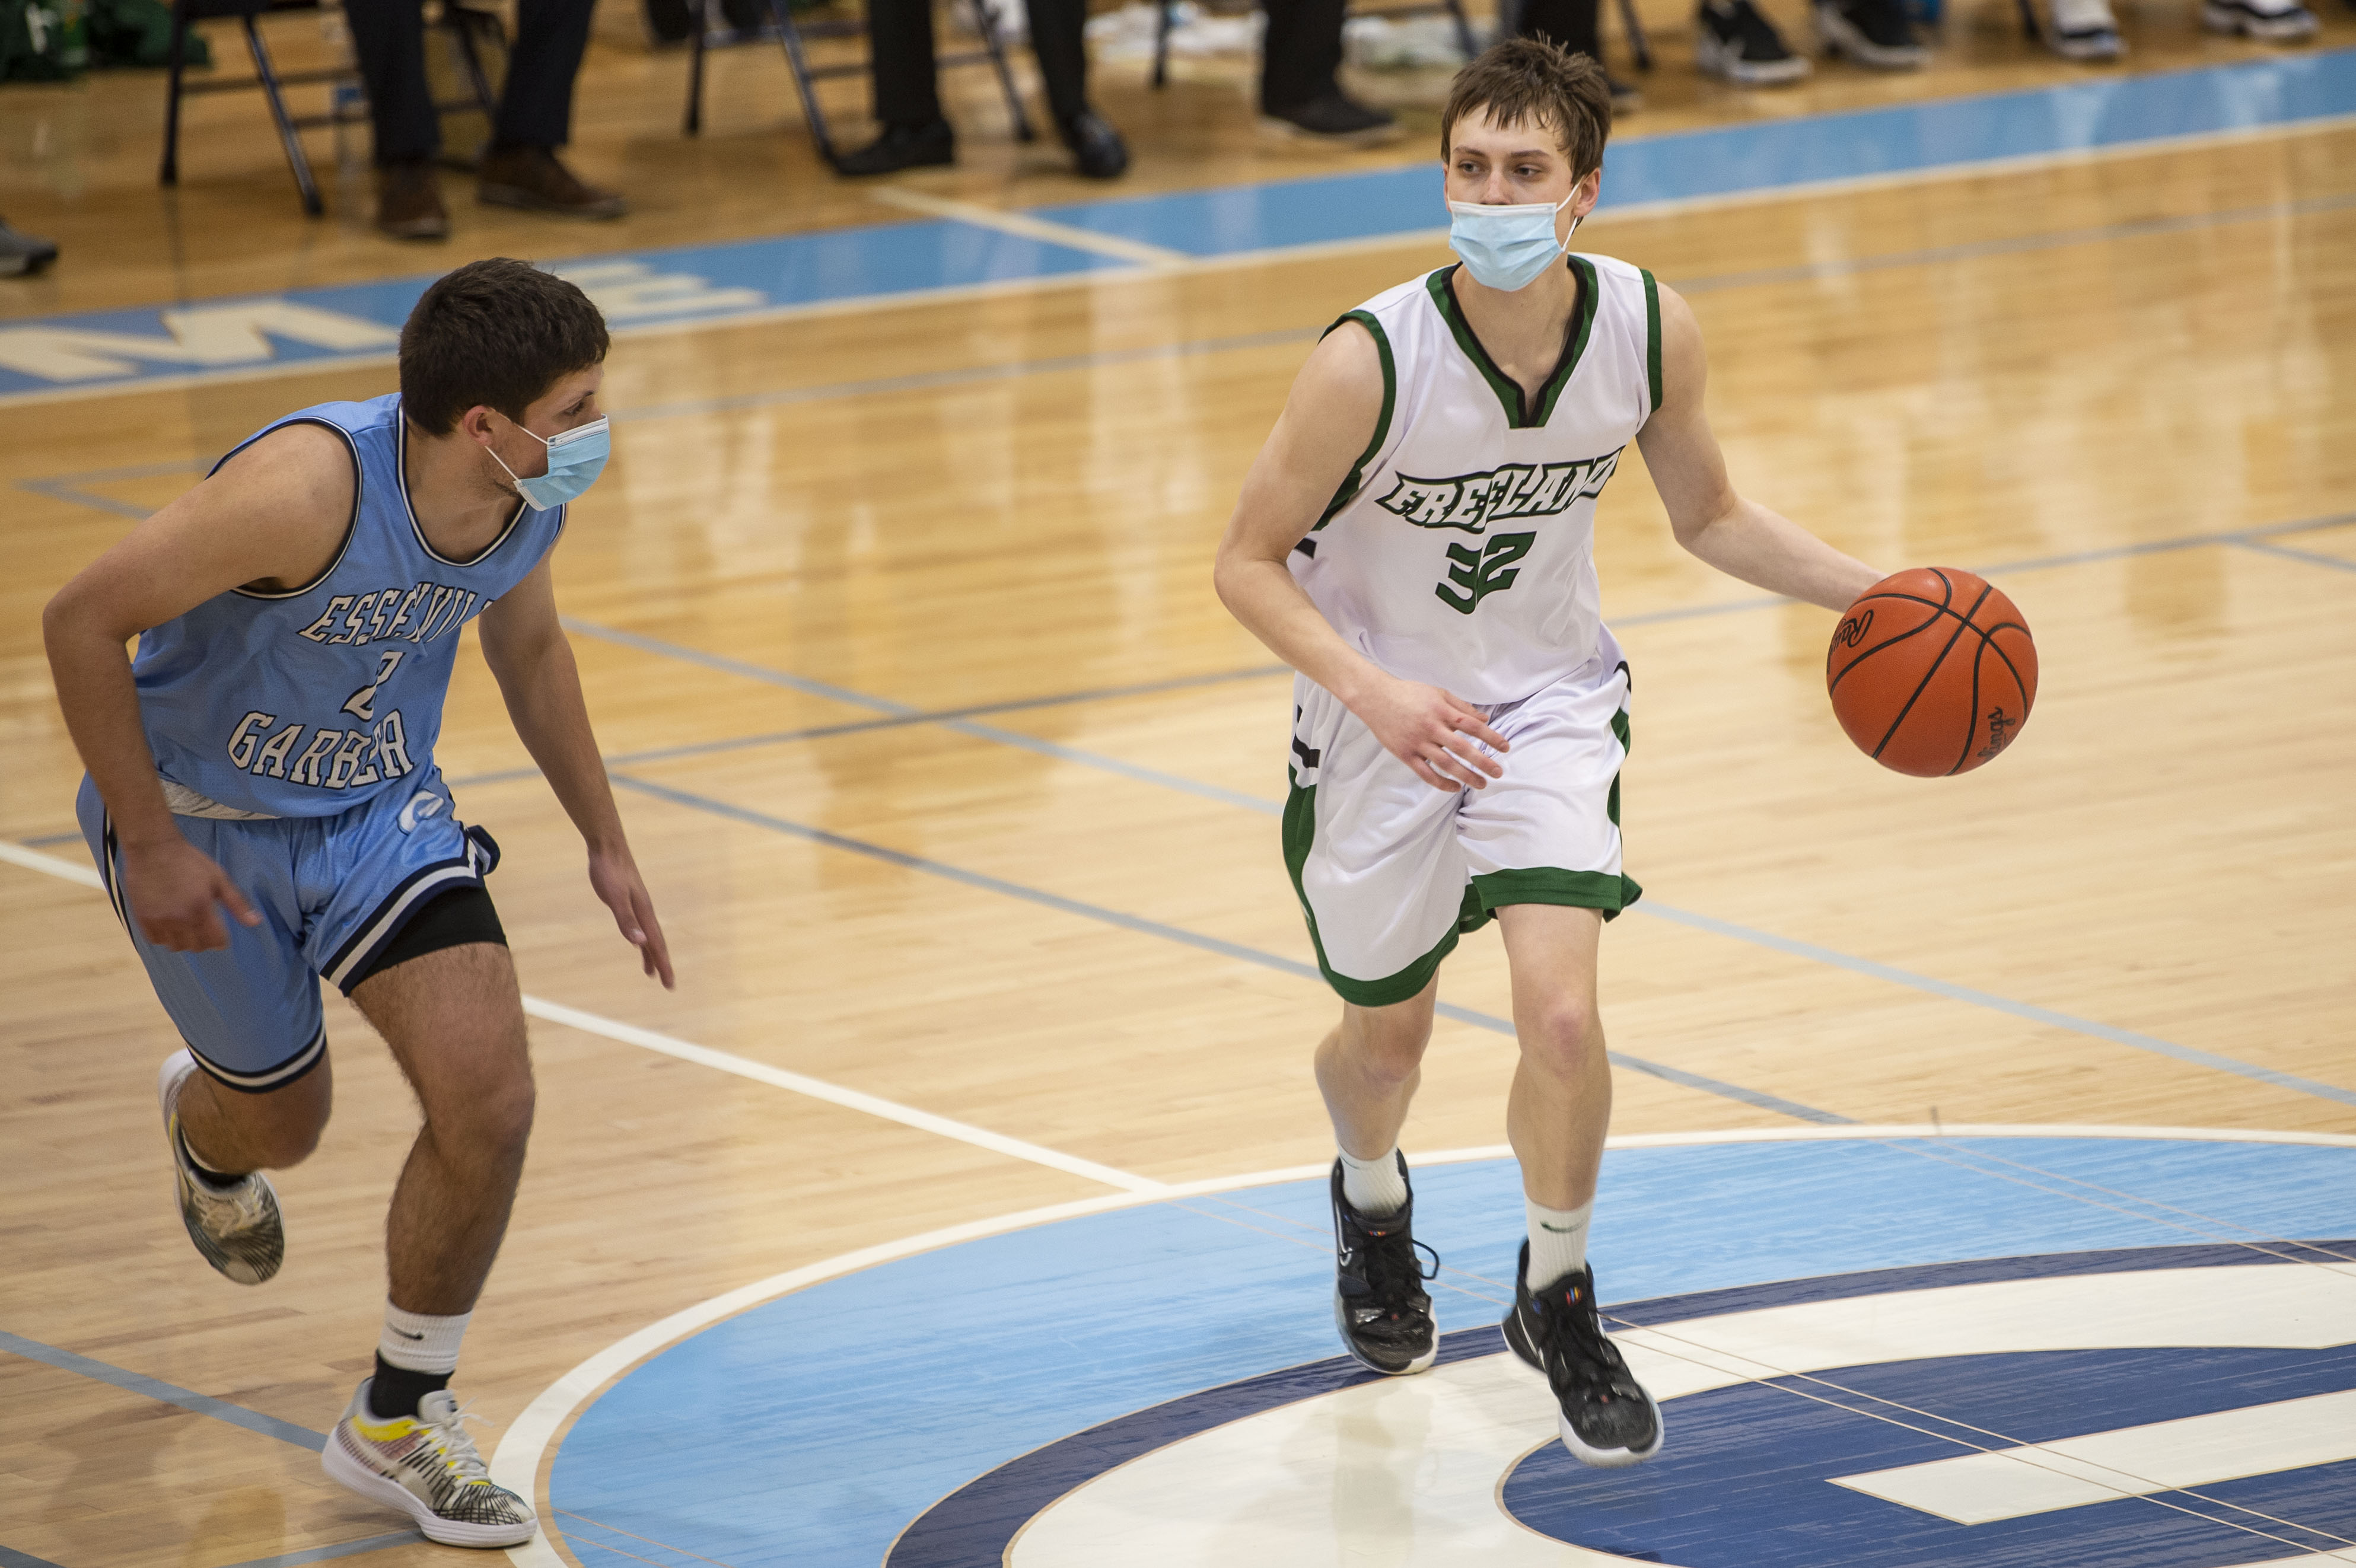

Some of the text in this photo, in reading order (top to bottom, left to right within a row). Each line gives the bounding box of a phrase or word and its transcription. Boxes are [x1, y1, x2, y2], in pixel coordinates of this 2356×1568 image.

[1374, 445, 1626, 534] FREELAND
[1435, 531, 1537, 615] 32
[339, 650, 407, 722] 2
[227, 707, 415, 789] GARBER
